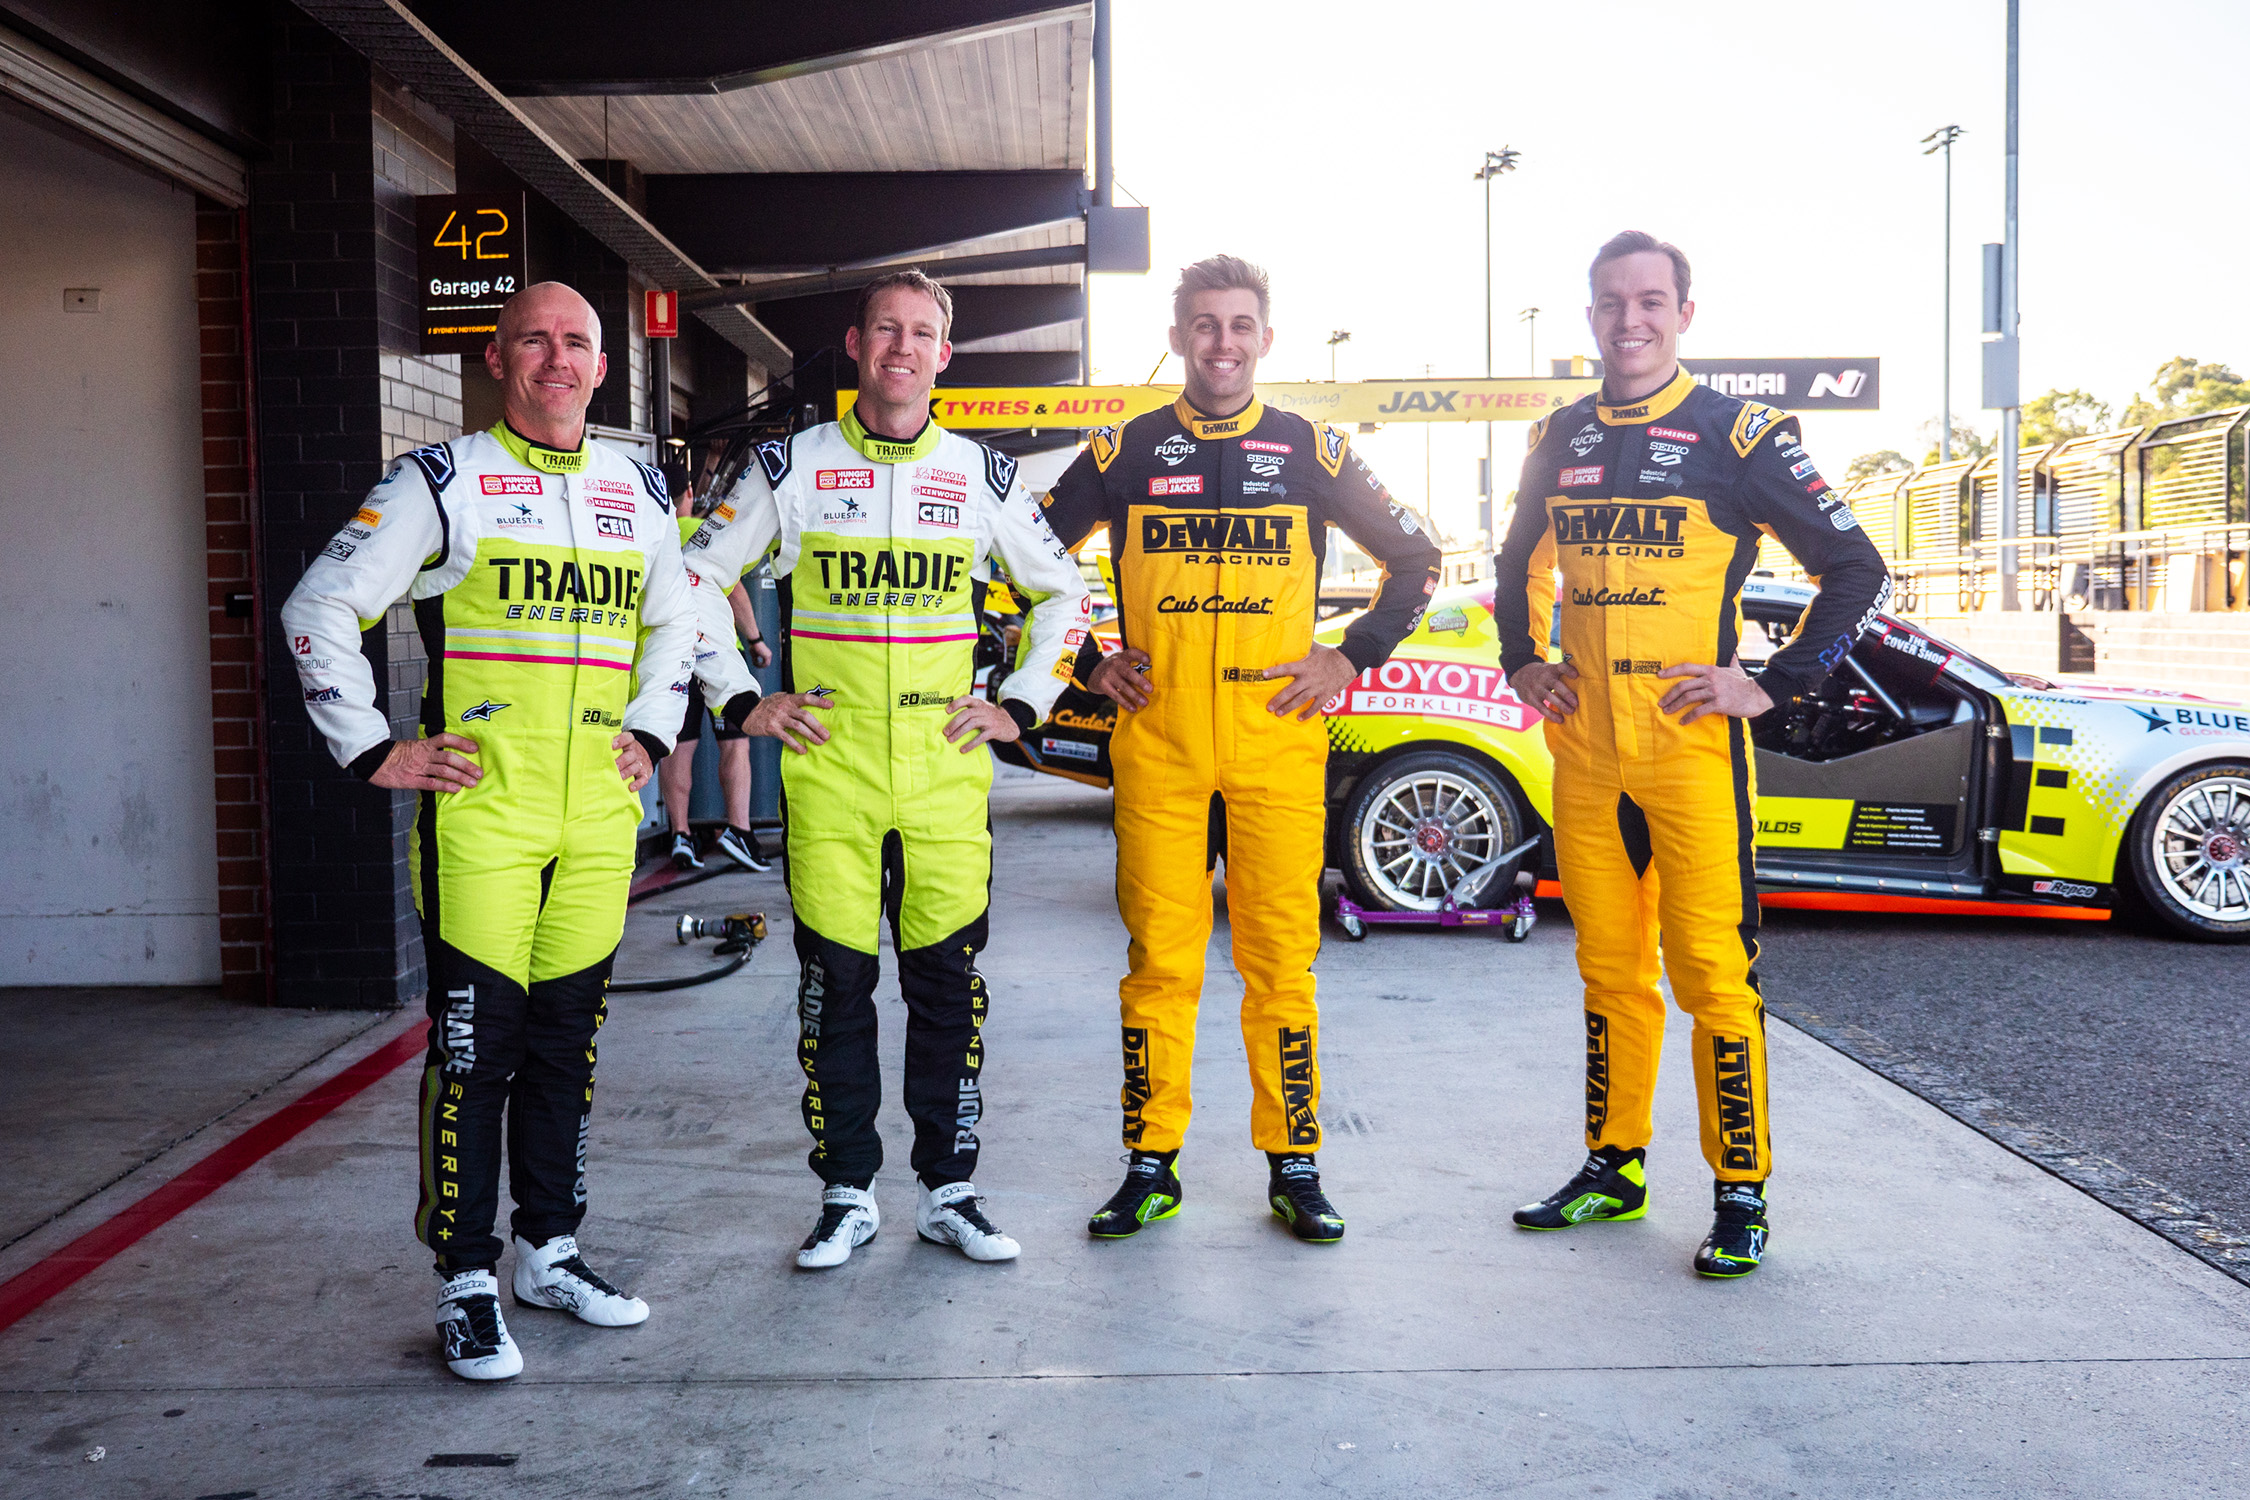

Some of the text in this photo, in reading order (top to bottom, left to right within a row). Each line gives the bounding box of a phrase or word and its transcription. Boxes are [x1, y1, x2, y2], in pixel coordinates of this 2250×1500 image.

[433, 208, 509, 260] 42
[430, 275, 515, 298] Garage 42
[944, 400, 1030, 416] TYRES
[1034, 404, 1049, 415] &
[1053, 399, 1126, 415] AUTO
[1377, 390, 1565, 414] JAX TYRES &
[1569, 432, 1604, 448] FUCHS
[1662, 429, 1697, 441] HINO
[875, 444, 916, 456] TRADIE
[1154, 444, 1197, 455] FUCHS
[1256, 442, 1289, 452] HINO
[1648, 441, 1690, 455] SEIKO
[541, 453, 583, 467] TRADIE
[1246, 453, 1285, 466] SEIKO
[837, 470, 871, 478] HUNGRY
[931, 468, 967, 481] TOYOTA
[1573, 466, 1602, 475] HUNGRY
[501, 476, 537, 484] HUNGRY
[598, 479, 633, 490] TOYOTA
[1168, 476, 1200, 485] HUNGRY
[921, 487, 965, 501] KENWORTH
[594, 498, 634, 511] KENWORTH
[1581, 546, 1685, 558] RACING
[1185, 554, 1291, 566] RACING
[813, 550, 965, 592] TRADIE
[489, 558, 641, 611] TRADIE
[1572, 587, 1593, 606] Cub
[1157, 595, 1198, 614] Cub
[1908, 634, 1929, 650] THE
[1883, 634, 1947, 666] COVER SHOP
[1613, 660, 1630, 673] 18
[1222, 668, 1240, 682] 18
[1361, 660, 1523, 704] TOYOTA
[900, 692, 920, 707] 20
[1366, 695, 1512, 722] FORKLIFTS
[582, 709, 602, 724] 20
[2051, 881, 2096, 898] Repco
